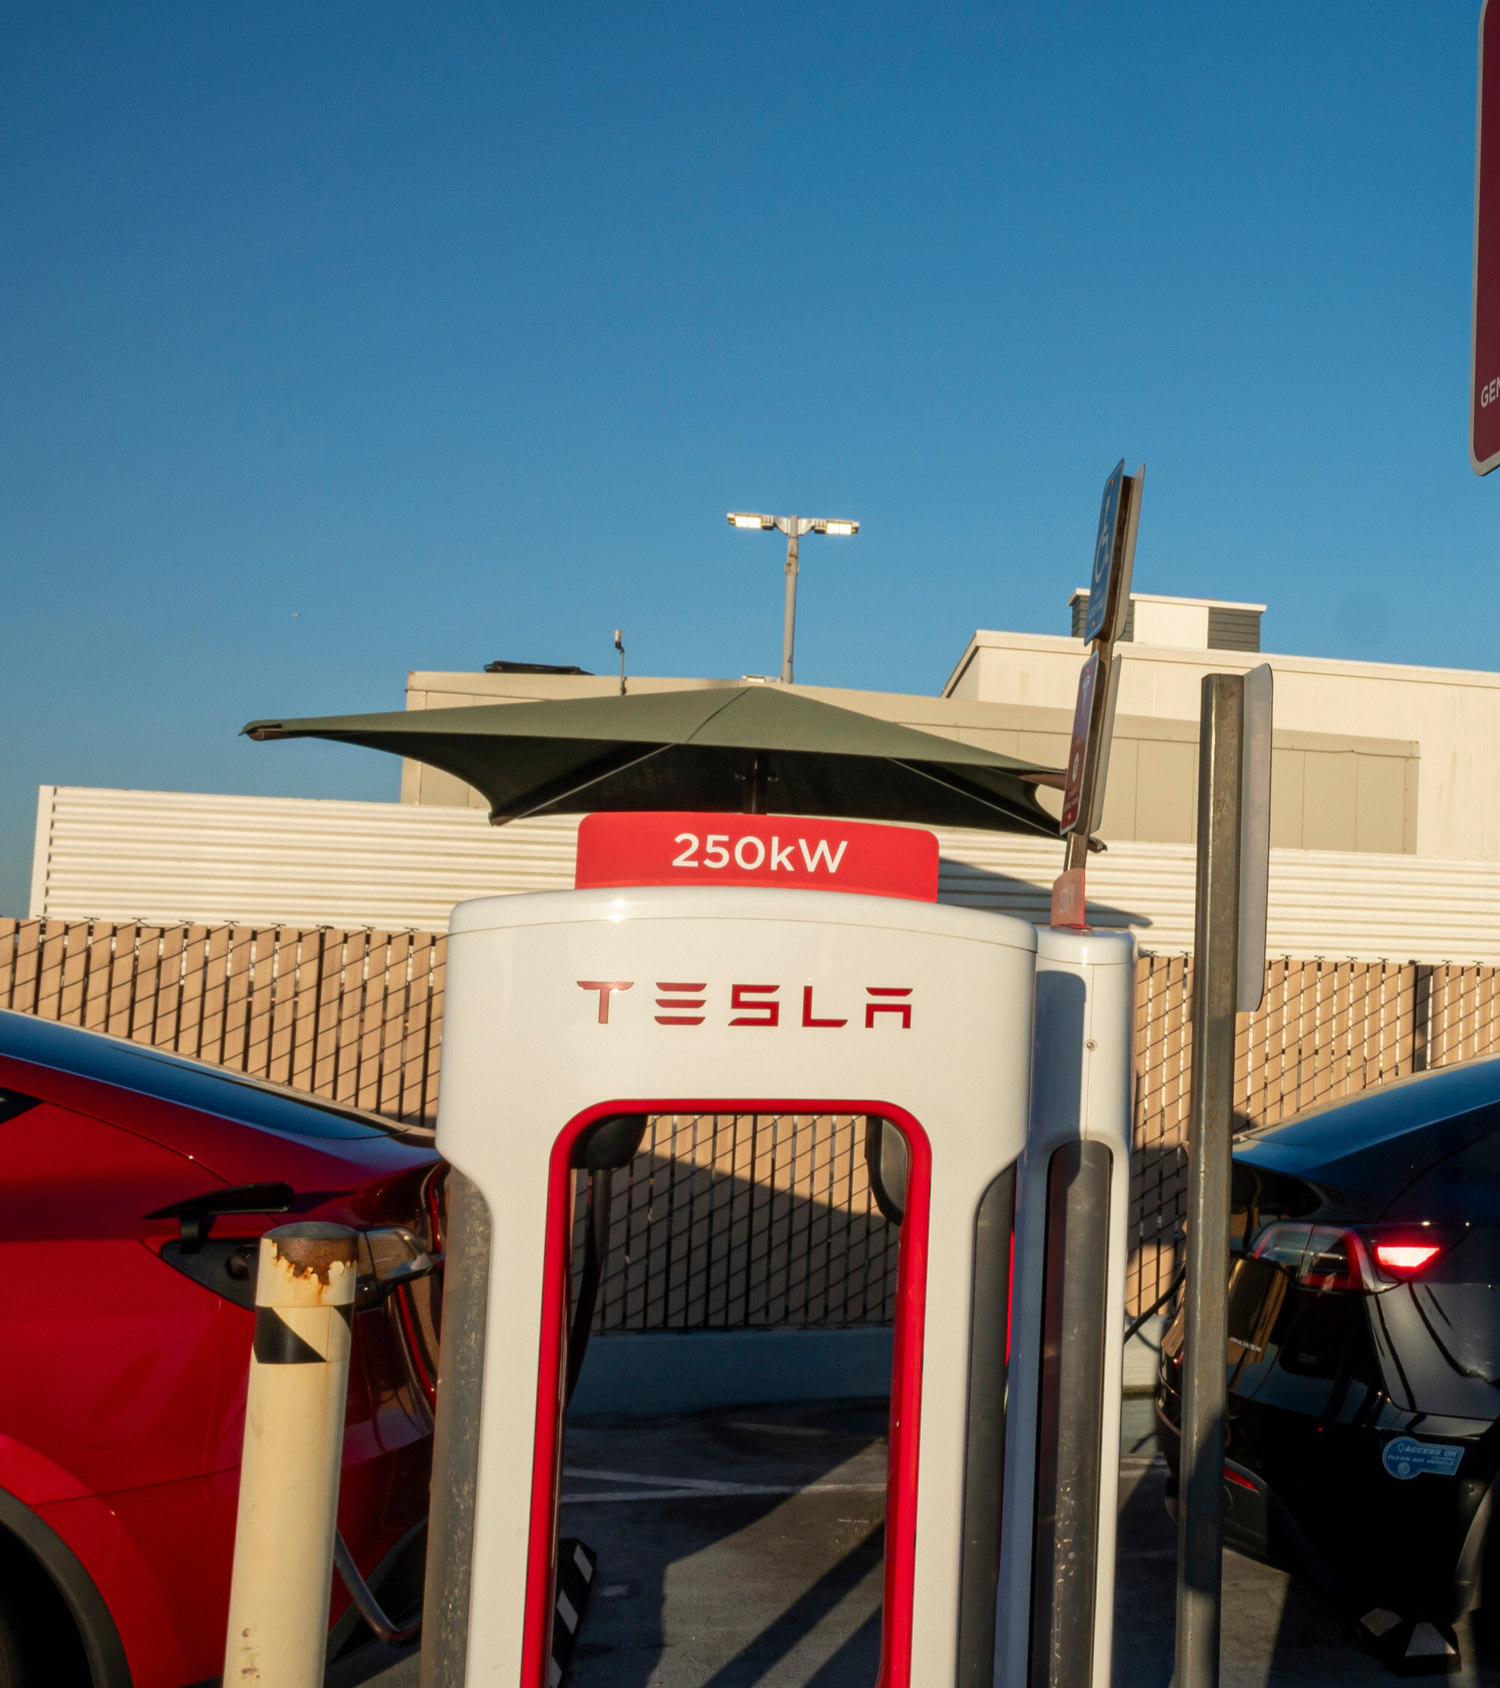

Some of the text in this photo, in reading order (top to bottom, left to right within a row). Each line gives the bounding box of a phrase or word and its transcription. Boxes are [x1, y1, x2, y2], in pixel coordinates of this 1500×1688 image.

[672, 832, 848, 873] 250kW
[576, 980, 914, 1029] TESLA
[1404, 1446, 1441, 1455] ACCESS
[1427, 1458, 1454, 1466] VEHICLE
